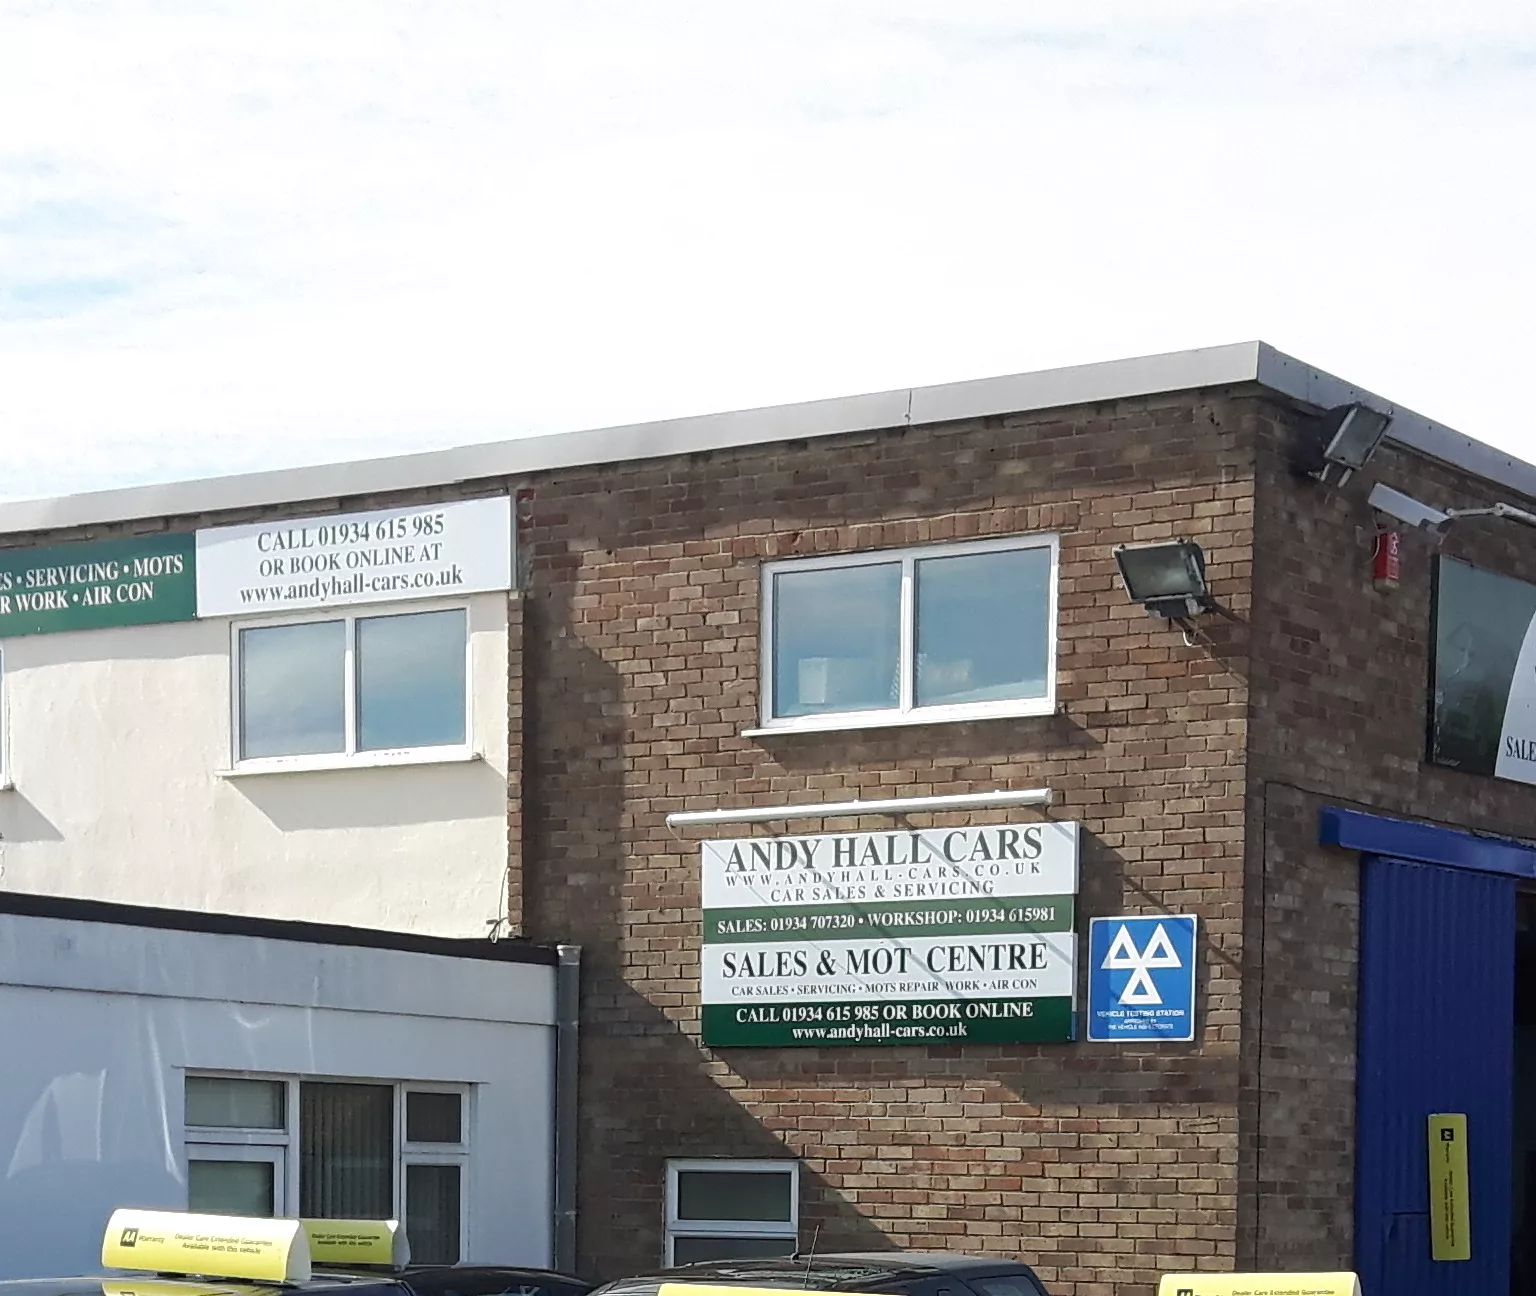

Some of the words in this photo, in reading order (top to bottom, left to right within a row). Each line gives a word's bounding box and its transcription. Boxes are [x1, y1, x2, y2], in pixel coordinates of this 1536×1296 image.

[258, 528, 314, 552] CALL
[318, 521, 370, 546] 01934
[376, 517, 407, 541] 615
[413, 513, 444, 536] 985
[26, 561, 119, 588] SERVICING
[132, 554, 184, 578] MOTS
[260, 558, 284, 577] OR
[290, 553, 341, 574] BOOK
[346, 545, 416, 569] ONLINE
[420, 542, 443, 562] AT
[16, 589, 69, 612] WORK
[82, 585, 112, 607] AIR
[116, 581, 154, 603] CON
[240, 564, 464, 602] www.andyhall-cars.co.uk
[725, 839, 822, 873] ANDY
[832, 833, 932, 868] HALL
[943, 826, 1043, 863] CARS
[770, 888, 805, 903] CAR
[812, 885, 866, 901] SALES
[874, 885, 885, 898] &
[893, 880, 994, 898] SERVICING
[718, 918, 767, 934] SALES:
[770, 916, 807, 931] 01934
[809, 914, 855, 930] 707320
[867, 910, 963, 927] WORKSHOP:
[966, 908, 1005, 924] 01934
[1008, 906, 1055, 922] 615981
[722, 950, 808, 979] SALES
[816, 949, 837, 976] &
[846, 947, 911, 975] MOT
[927, 942, 1048, 973] CENTRE
[731, 985, 755, 996] CAR
[756, 985, 789, 996] SALES
[797, 984, 856, 995] SERVICING
[865, 982, 897, 993] MOTS
[899, 981, 939, 992] REPAIR
[945, 980, 980, 991] WORK
[990, 979, 1009, 990] AIR
[1012, 978, 1037, 989] CON
[736, 1007, 780, 1023] CALL
[782, 1006, 822, 1021] 01934
[826, 1006, 851, 1021] 615
[854, 1005, 879, 1020] 985
[882, 1004, 908, 1020] OR
[912, 1003, 962, 1019] BOOK
[966, 1002, 1033, 1018] ONLINE
[792, 1022, 967, 1041] www.andyhall-cars.co.uk
